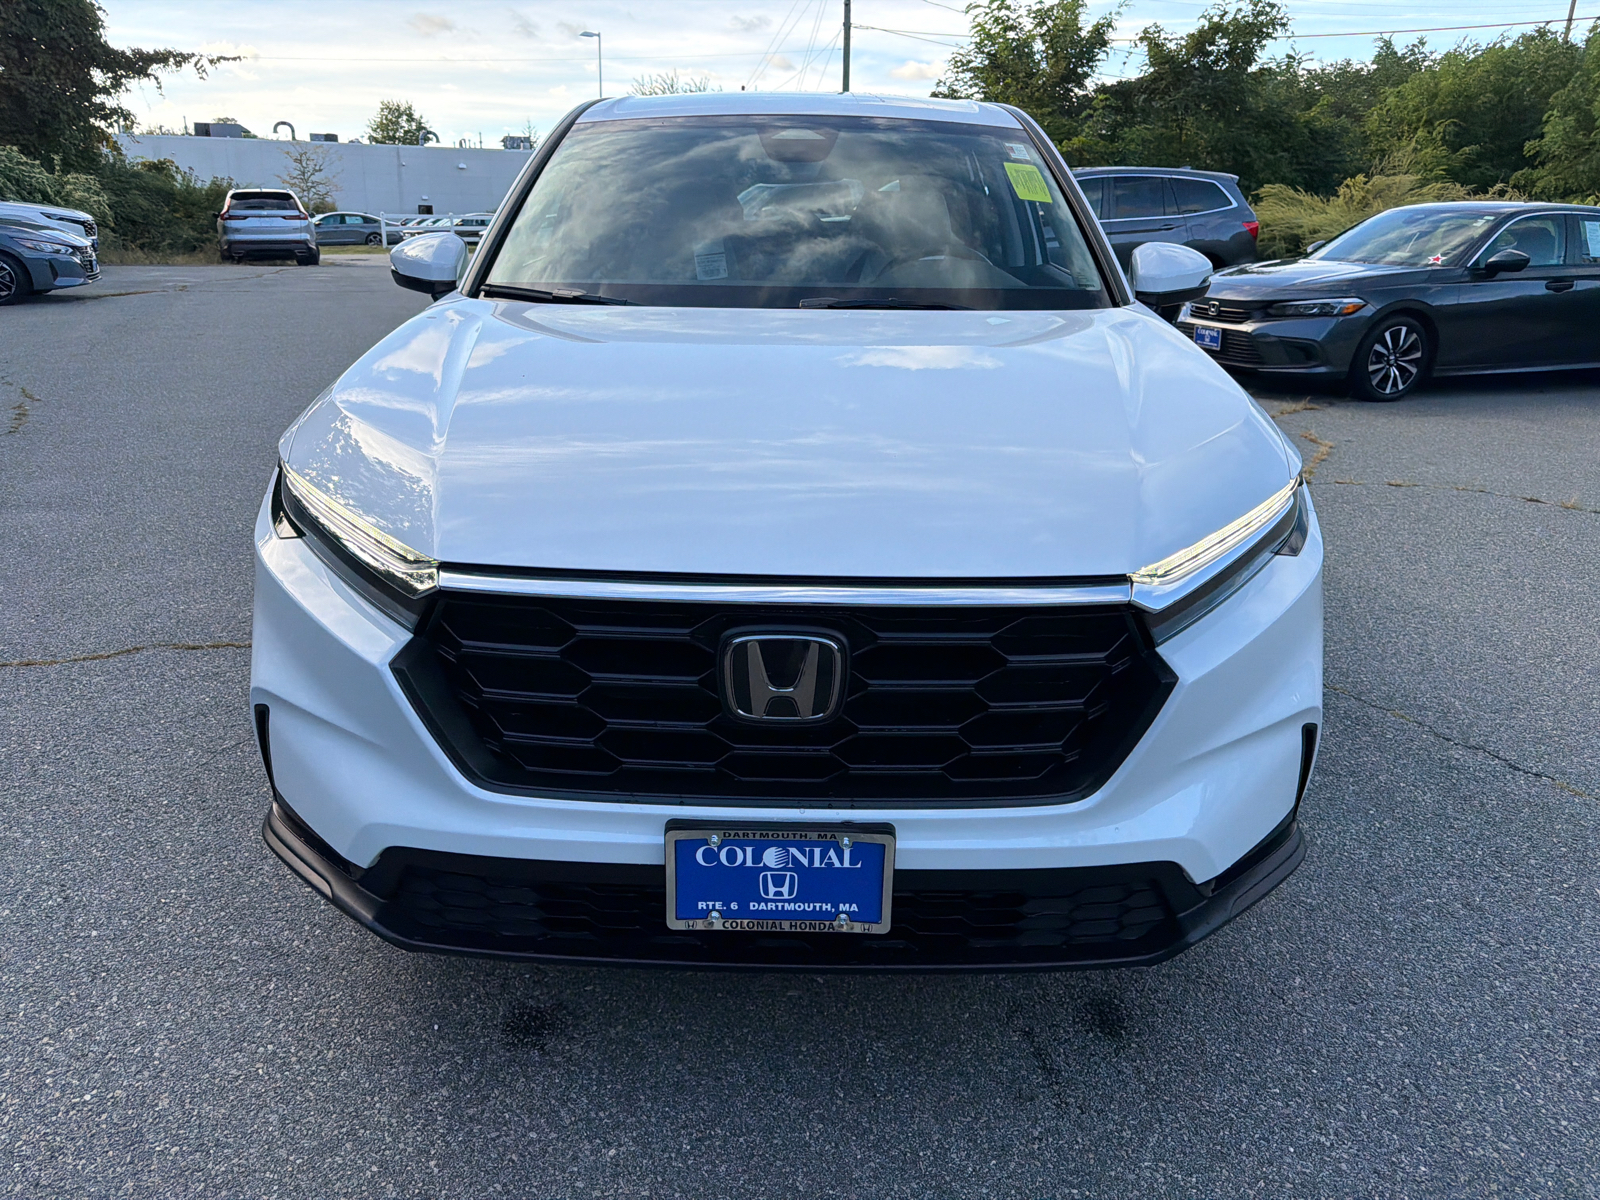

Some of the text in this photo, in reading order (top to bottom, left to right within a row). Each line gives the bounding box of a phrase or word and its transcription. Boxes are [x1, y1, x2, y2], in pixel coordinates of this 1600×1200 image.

[695, 845, 862, 868] COLONIAL
[697, 901, 859, 913] RTE. 6 DARTMOUTH, MA
[722, 920, 836, 931] COLONIAL HONDA
